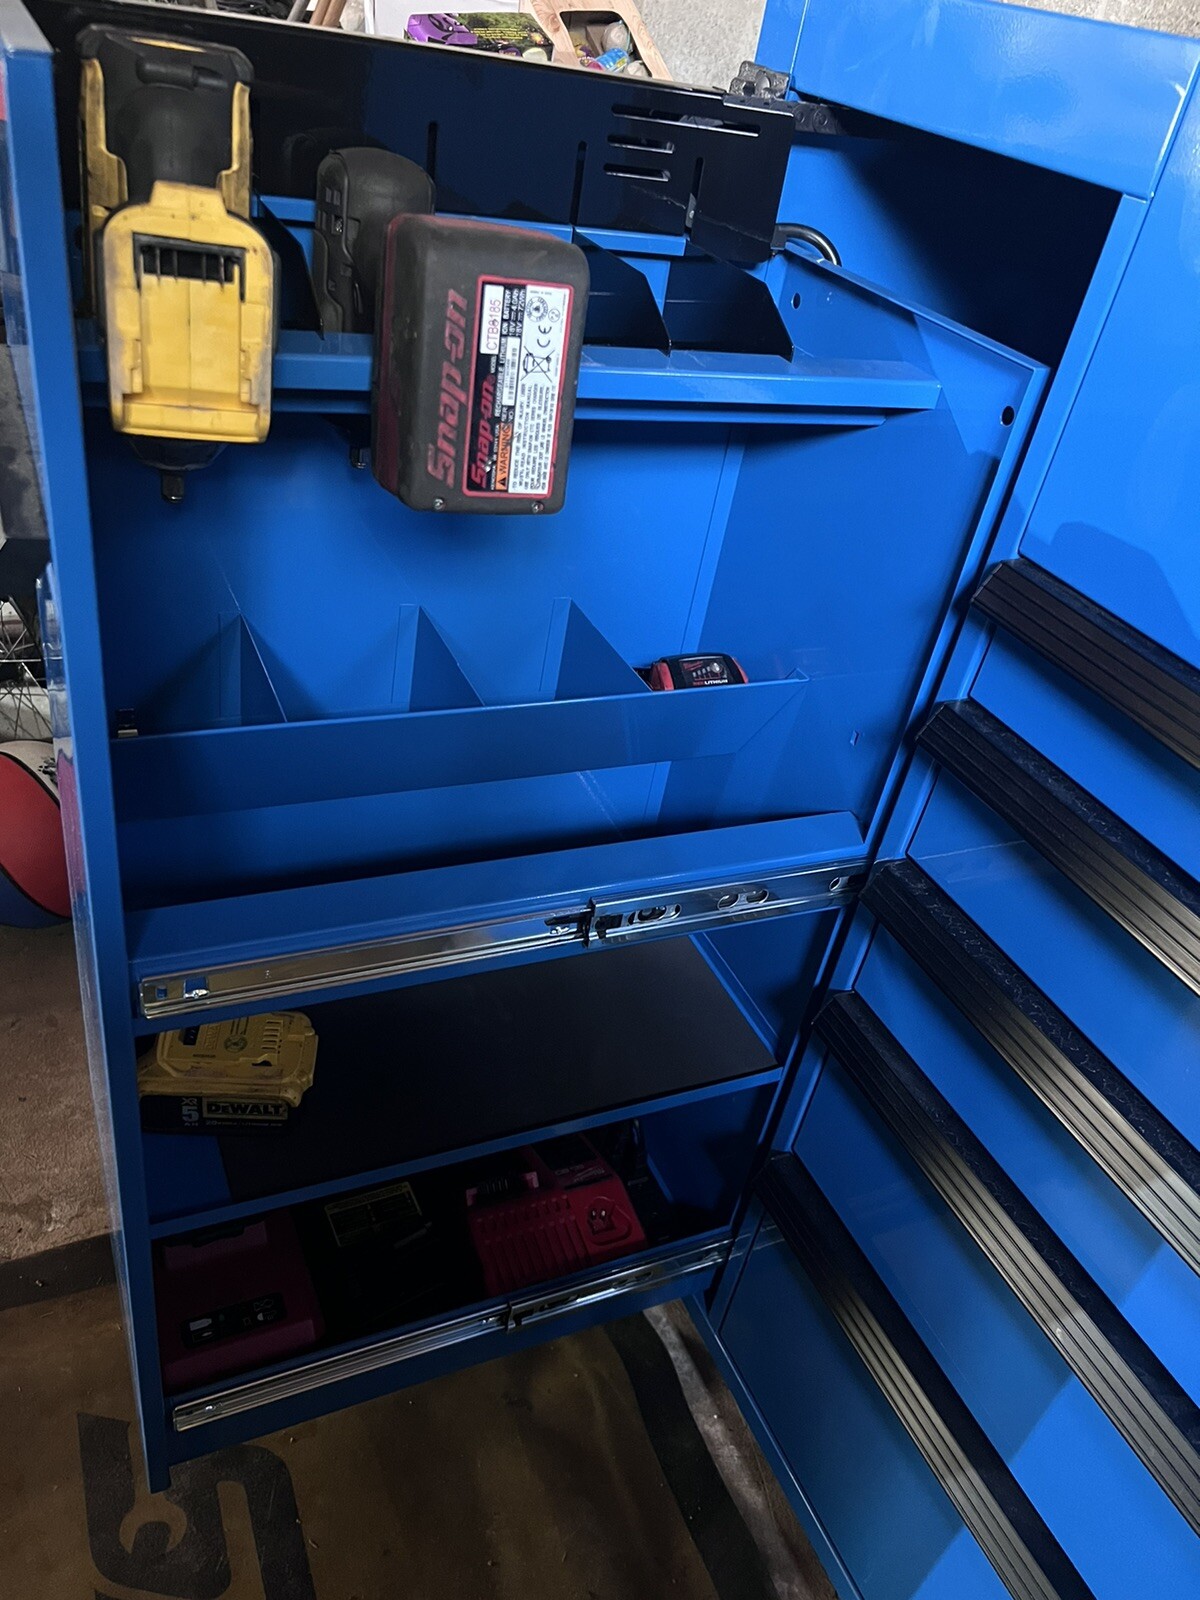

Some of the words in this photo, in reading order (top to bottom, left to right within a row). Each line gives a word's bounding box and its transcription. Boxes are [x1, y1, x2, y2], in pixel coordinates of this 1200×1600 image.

[427, 289, 468, 488] Snap-on
[495, 366, 504, 416] RECHARGEABLE
[503, 289, 511, 319] BATTERY
[471, 380, 494, 488] Snap-on
[499, 422, 511, 474] WARNING
